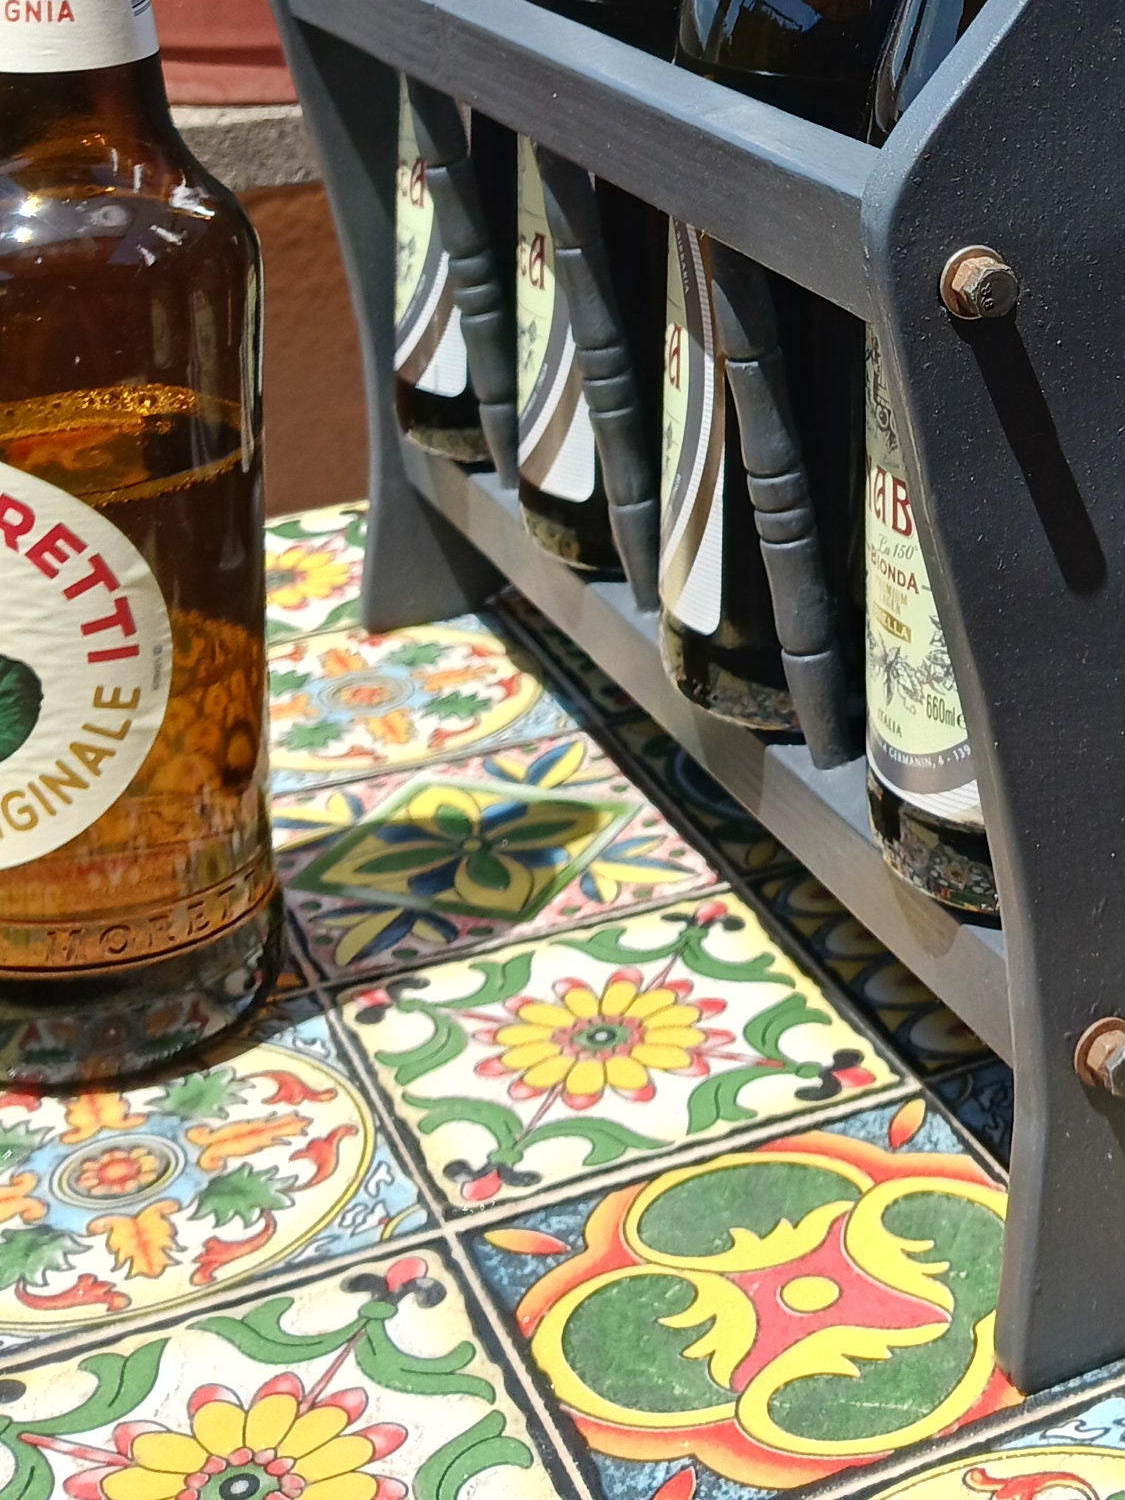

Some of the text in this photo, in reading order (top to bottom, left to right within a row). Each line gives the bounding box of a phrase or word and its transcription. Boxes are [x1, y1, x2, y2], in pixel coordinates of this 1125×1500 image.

[4, 0, 75, 23] GNIA
[0, 493, 139, 664] RETTI
[878, 708, 902, 738] ITALIA
[926, 694, 956, 728] 660ml
